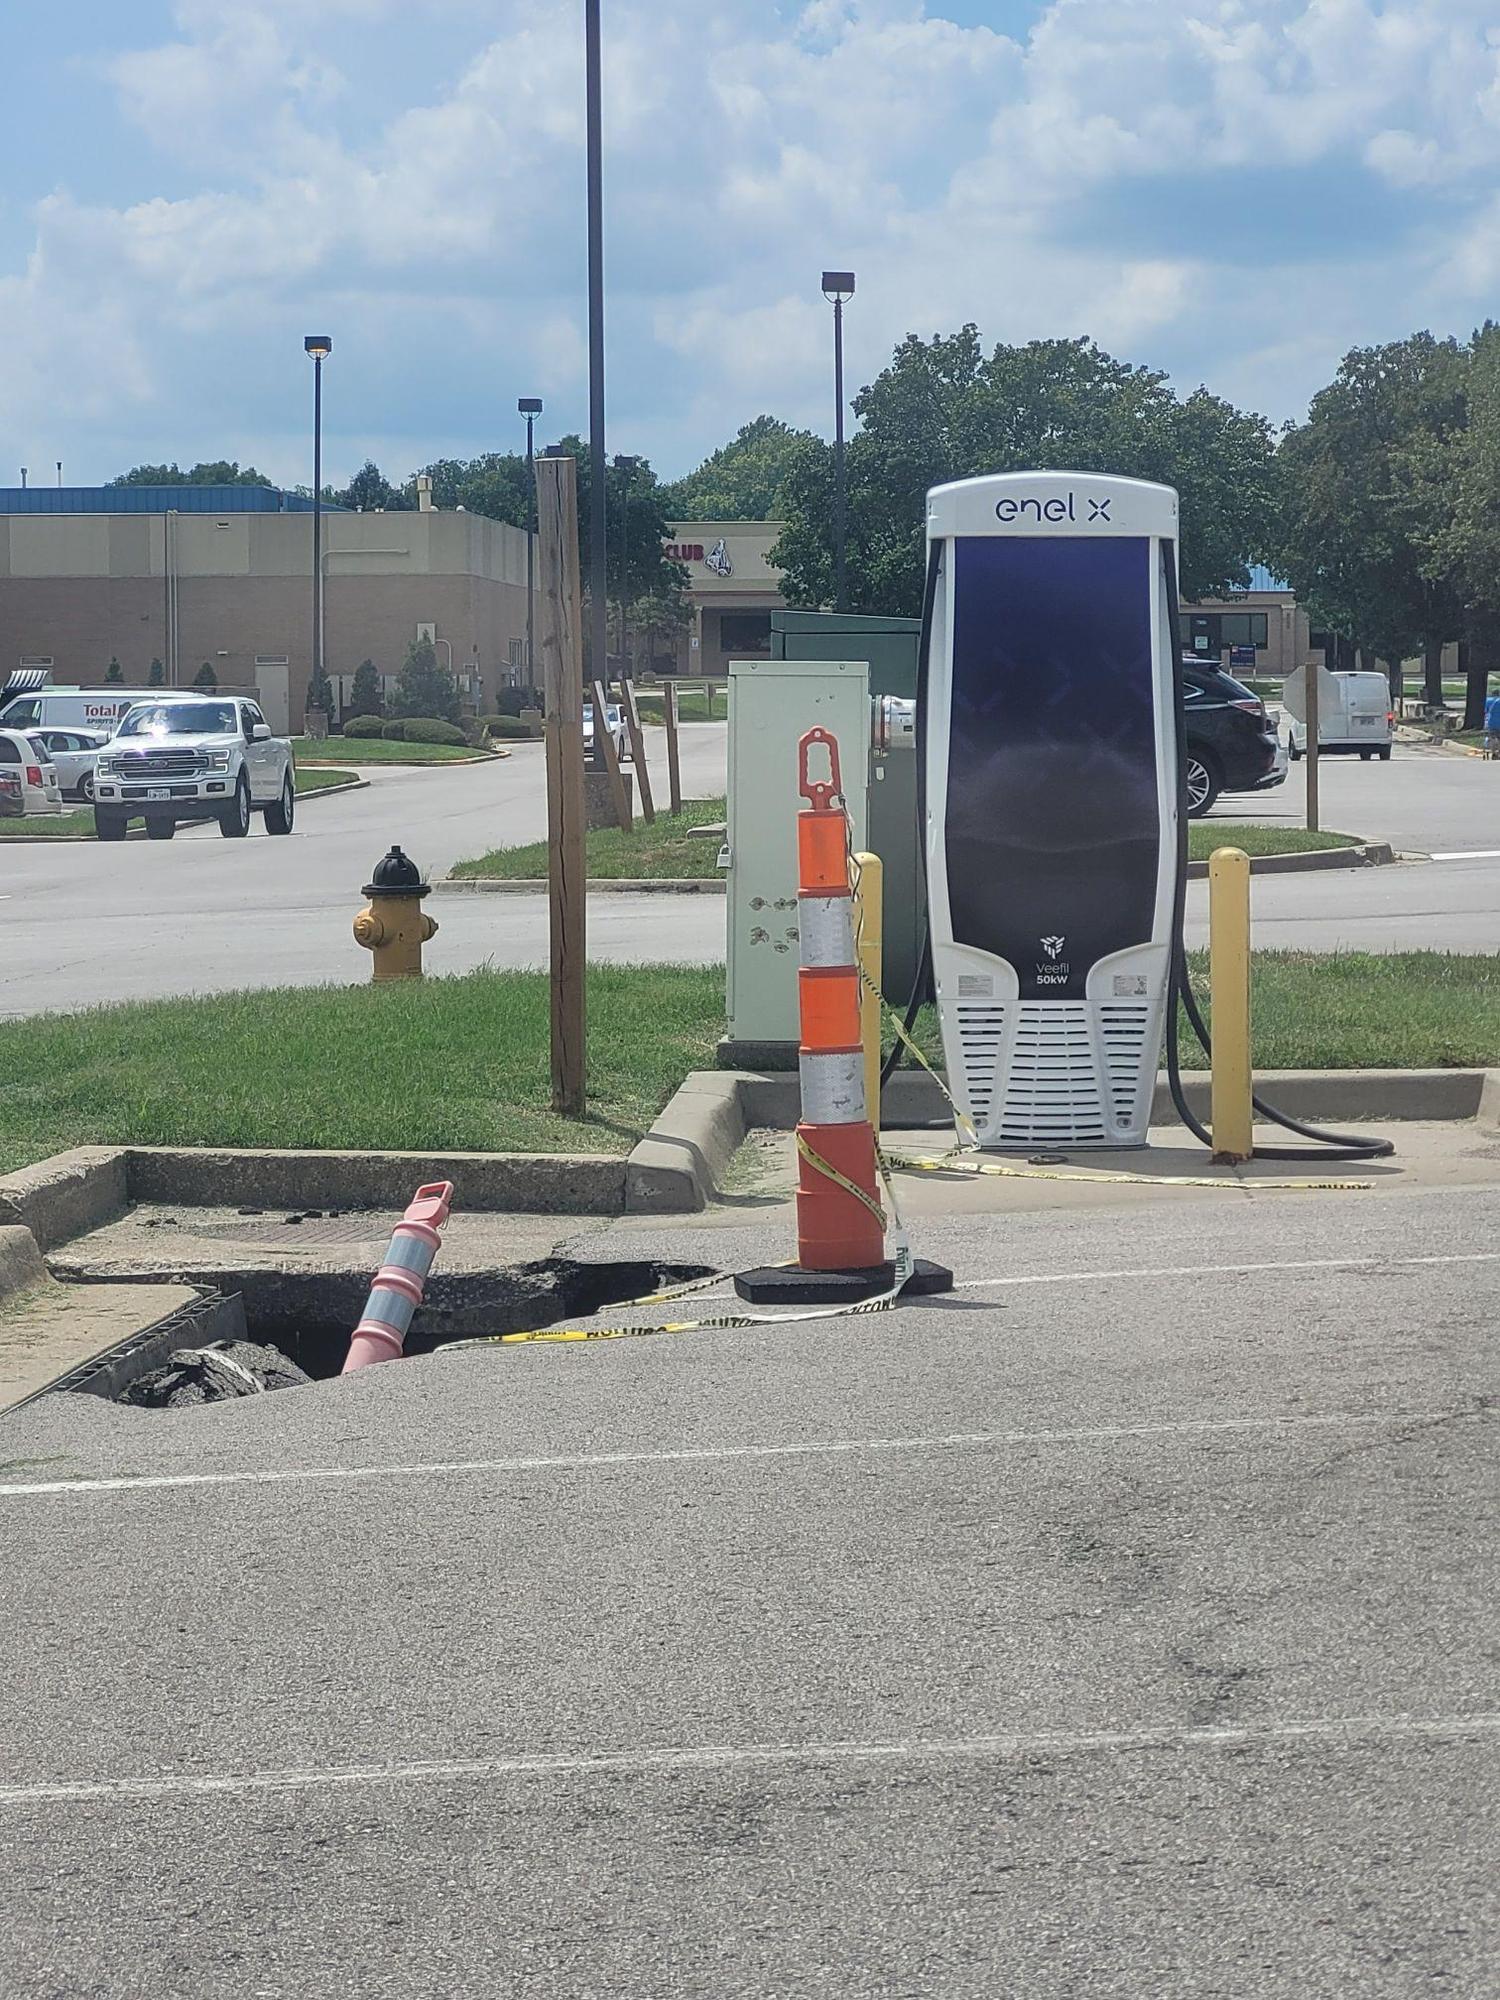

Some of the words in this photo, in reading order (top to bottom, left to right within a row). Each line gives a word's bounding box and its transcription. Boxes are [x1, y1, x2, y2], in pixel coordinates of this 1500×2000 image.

[995, 491, 1076, 522] enel
[665, 544, 704, 561] CLUB
[83, 703, 117, 717] Total
[1036, 962, 1070, 974] Veefil
[1036, 975, 1069, 985] 50kW
